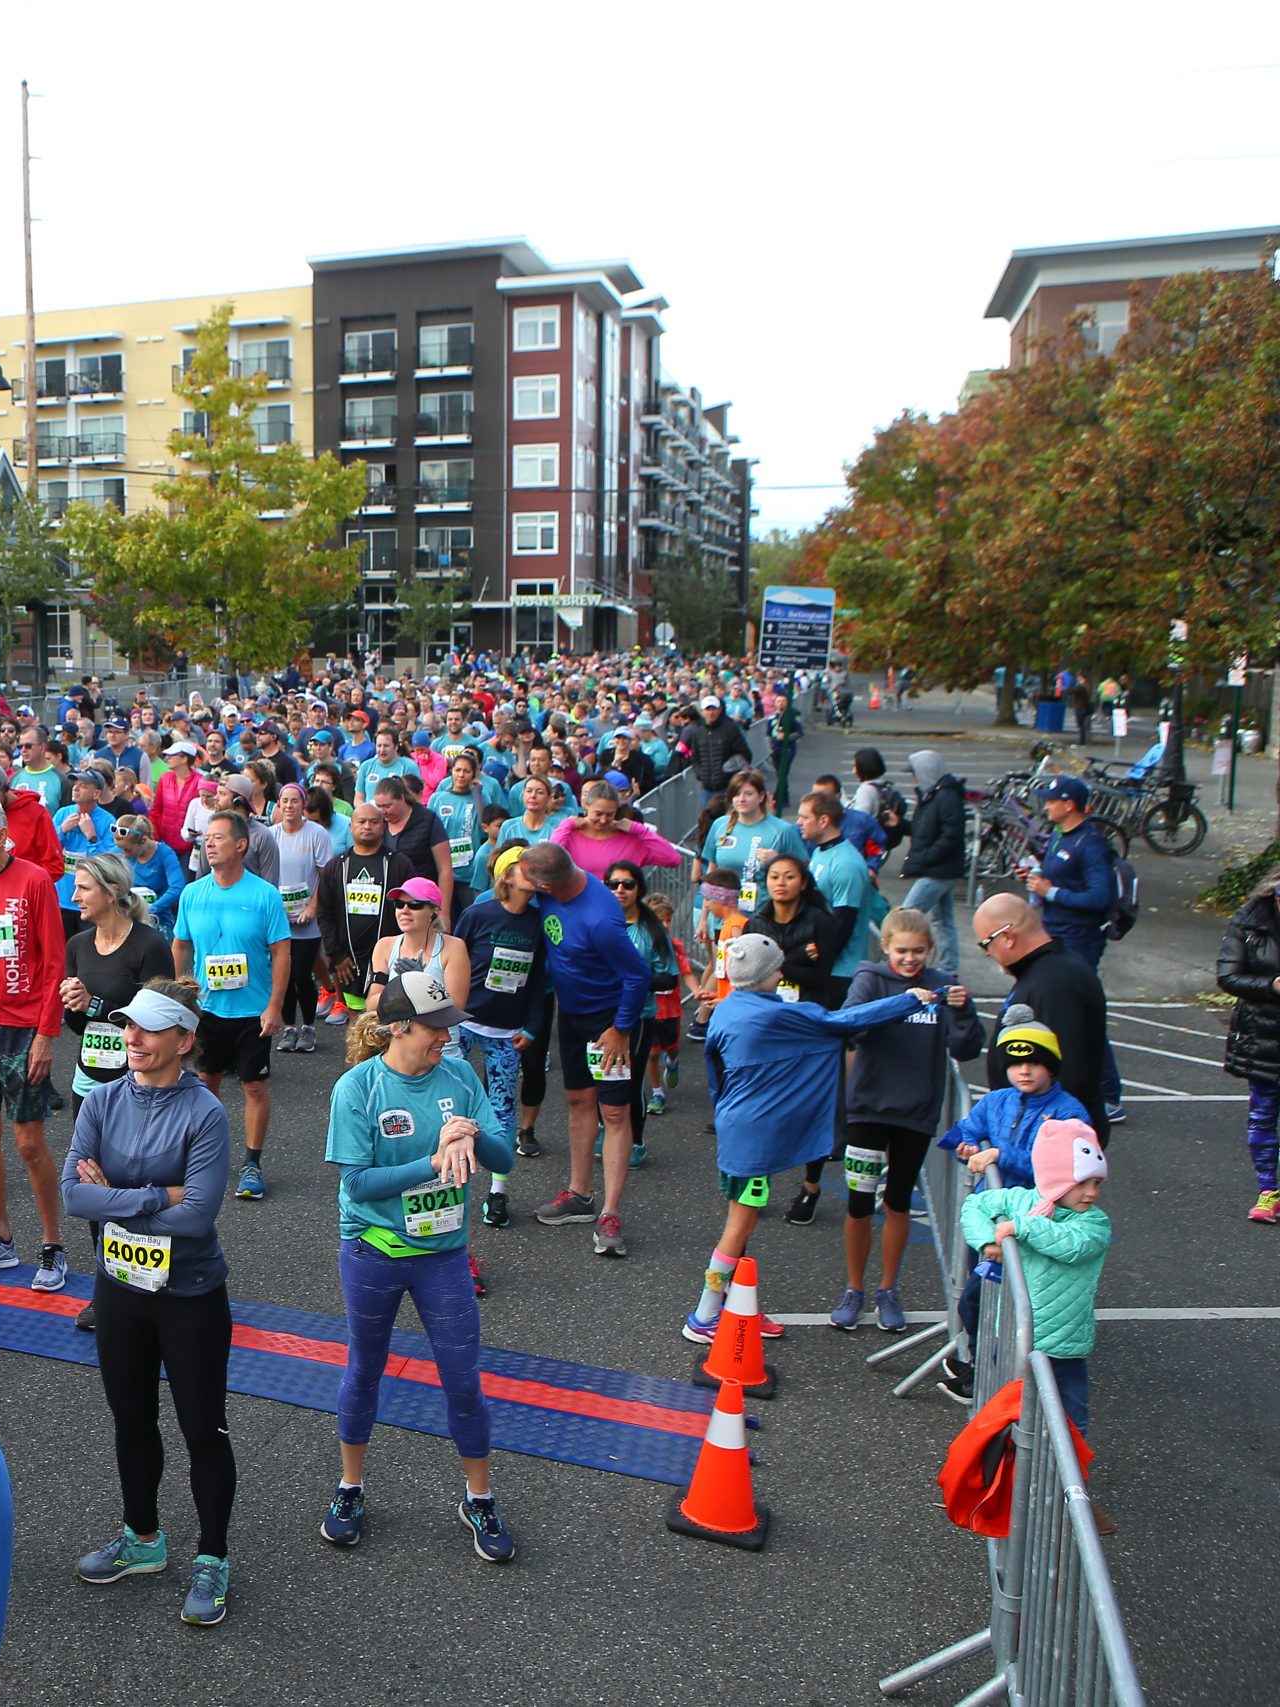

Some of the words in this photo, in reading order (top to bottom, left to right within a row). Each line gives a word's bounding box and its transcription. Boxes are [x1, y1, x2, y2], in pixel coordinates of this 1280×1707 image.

[561, 595, 601, 606] BREW
[349, 893, 378, 903] 4296
[20, 898, 28, 958] CAPITAL
[5, 898, 19, 994] MAHON
[208, 964, 242, 976] 4141
[494, 959, 528, 974] 3384
[20, 963, 30, 993] CITY
[85, 1034, 122, 1051] 3386
[407, 1187, 460, 1214] 3021
[436, 1219, 449, 1227] Erin
[111, 1229, 147, 1242] Bellingham
[147, 1236, 161, 1246] Bay
[107, 1240, 164, 1268] 4009
[117, 1271, 128, 1281] 5K
